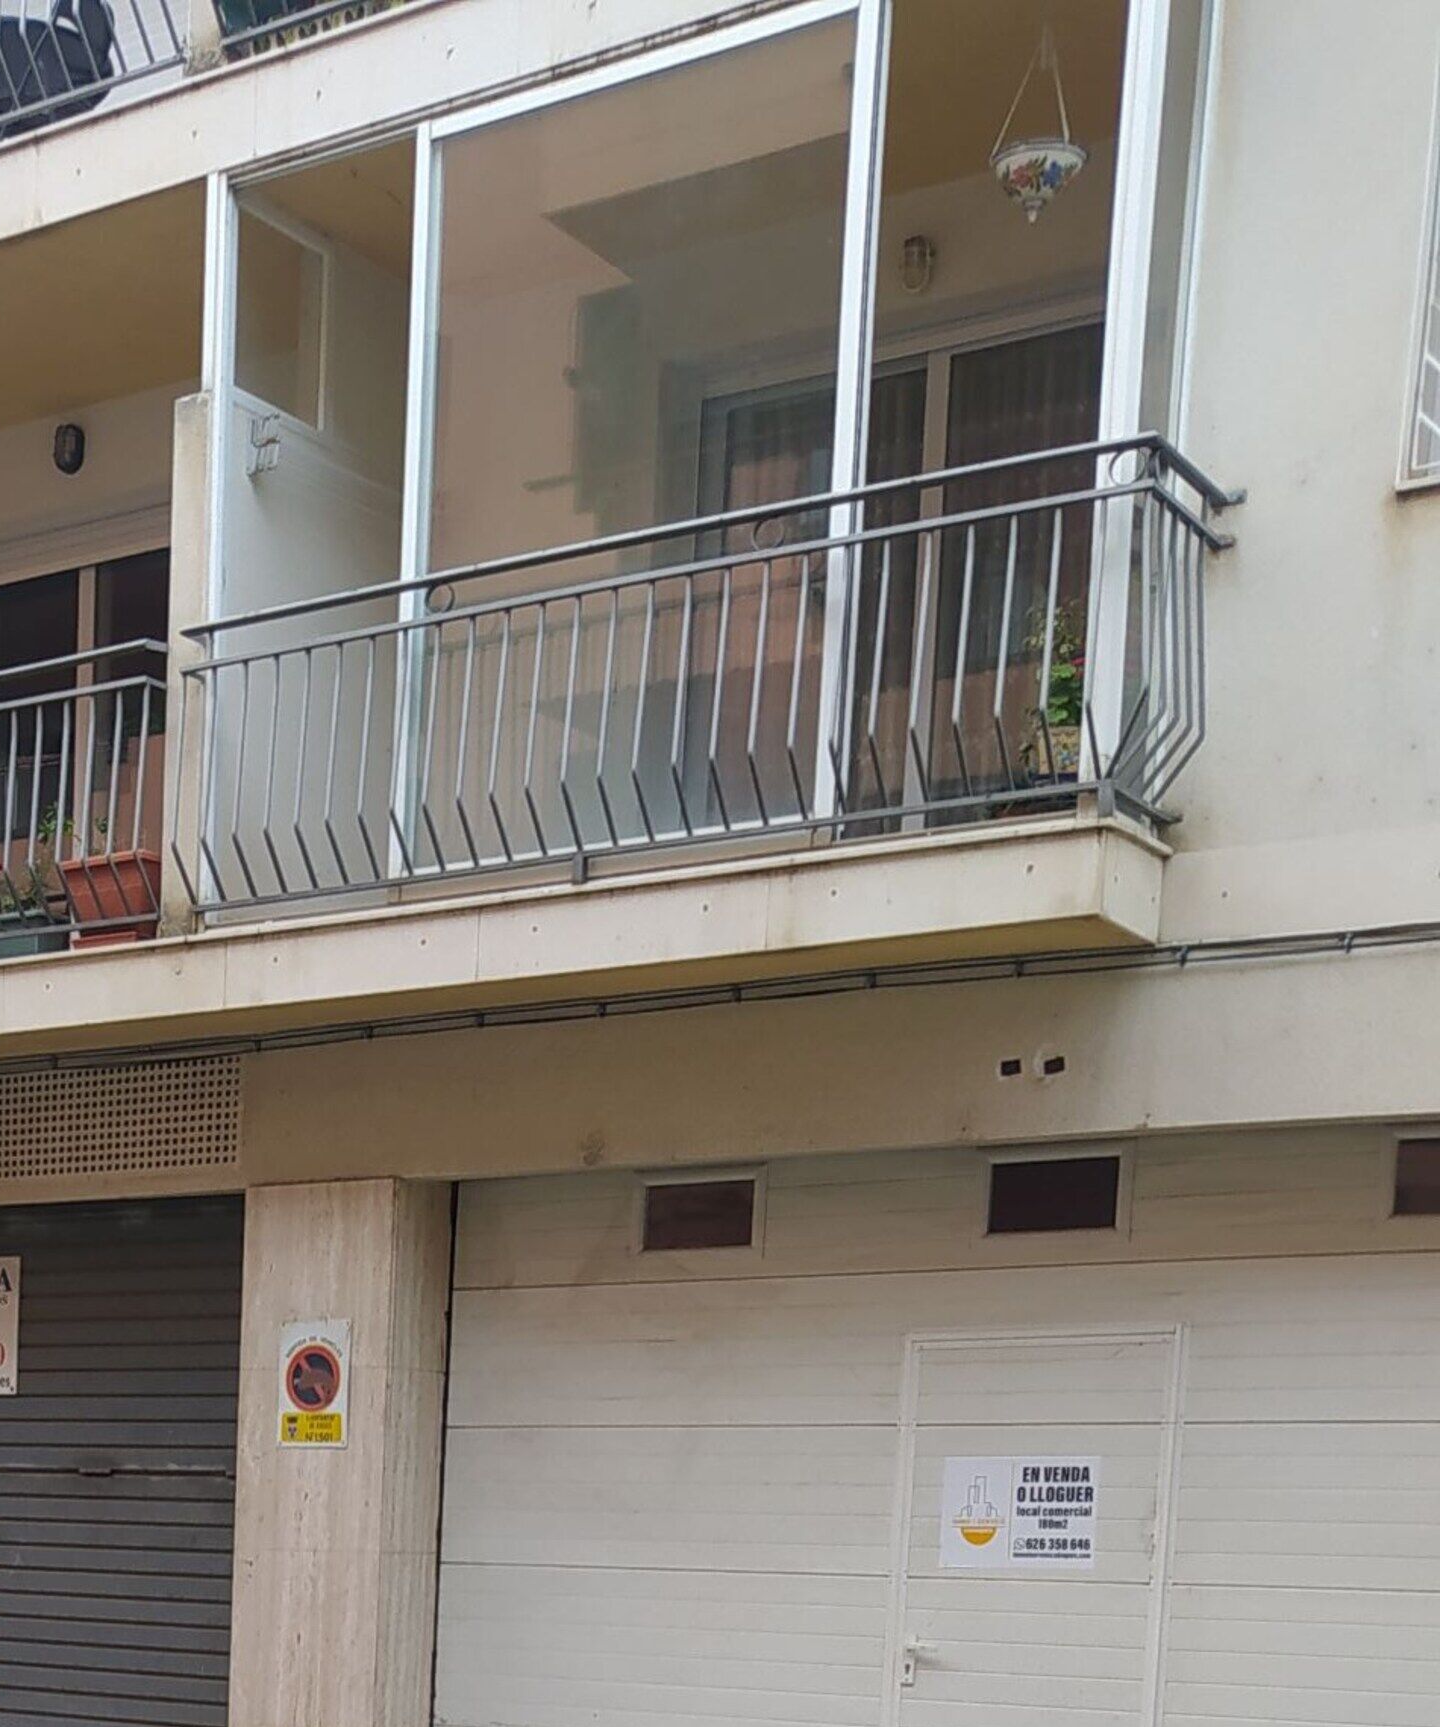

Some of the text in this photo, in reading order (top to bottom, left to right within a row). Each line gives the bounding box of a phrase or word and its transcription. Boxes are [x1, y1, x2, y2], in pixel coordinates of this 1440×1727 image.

[1022, 1466, 1090, 1483] EN VENDA
[1017, 1486, 1094, 1502] O LLOGUER
[1016, 1505, 1092, 1517] local comercial
